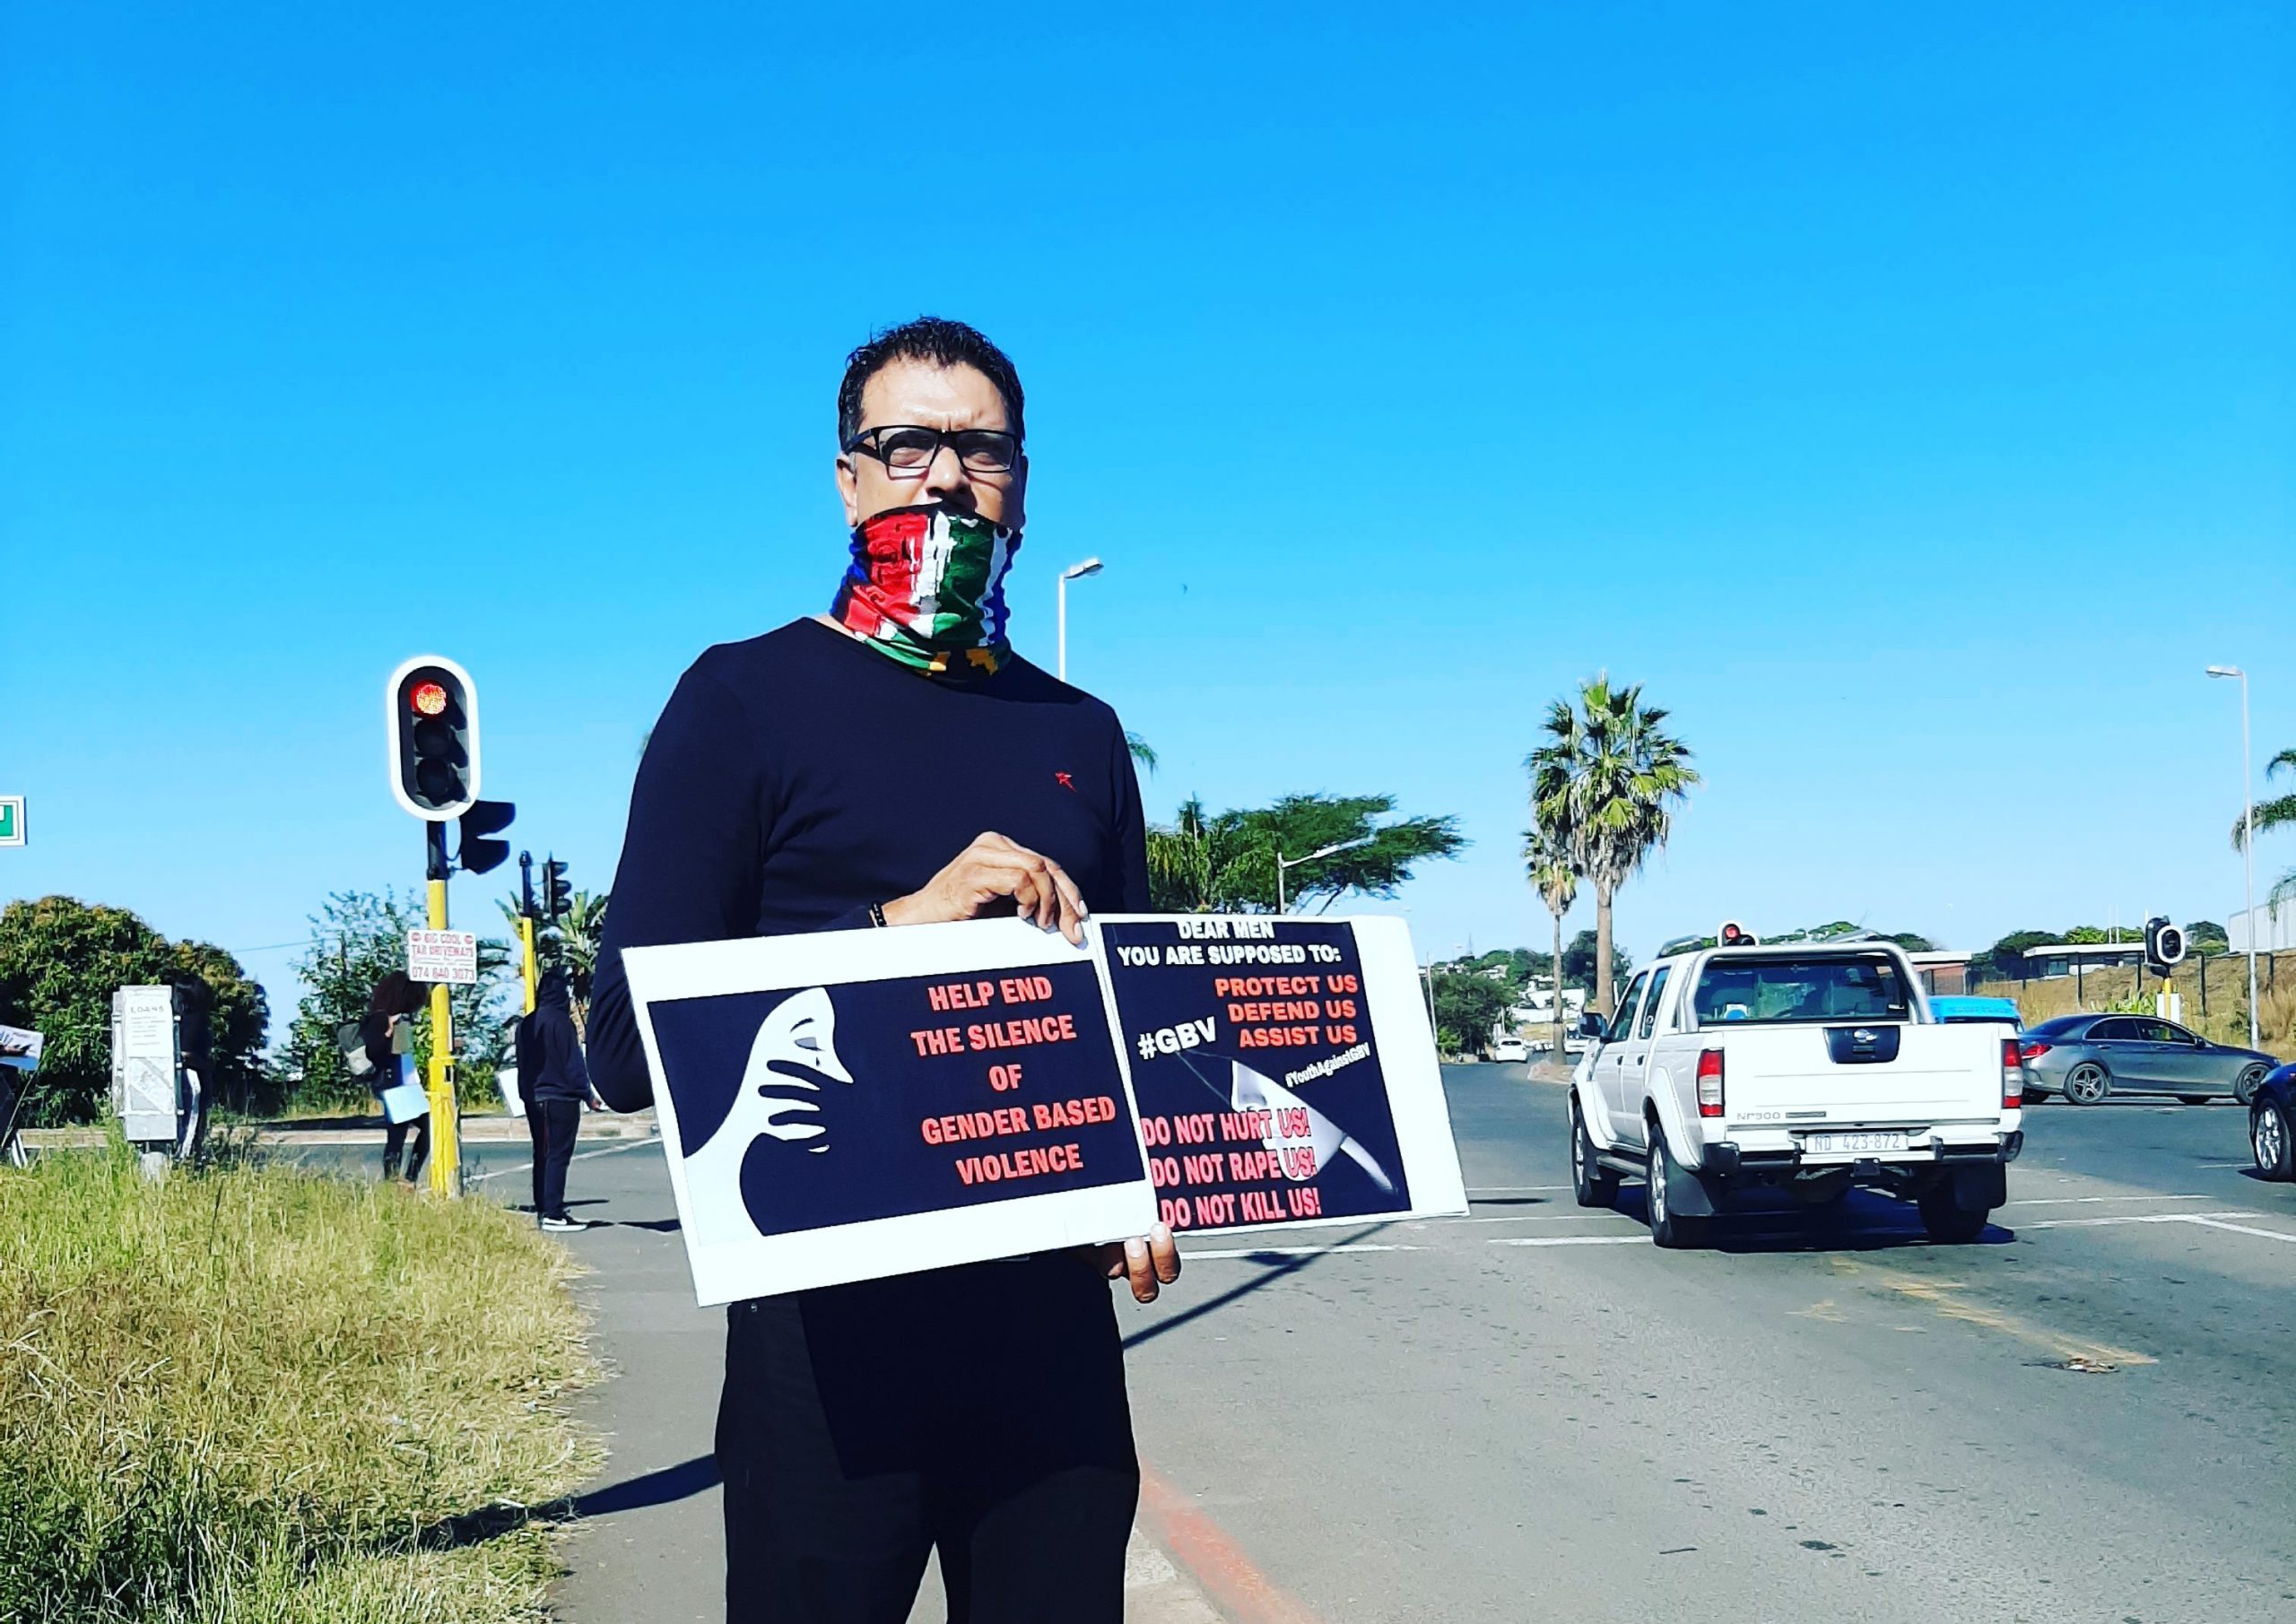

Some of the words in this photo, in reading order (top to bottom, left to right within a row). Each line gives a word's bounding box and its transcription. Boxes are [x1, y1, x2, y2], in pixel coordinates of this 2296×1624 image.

[1177, 921, 1229, 939] DEAR
[1232, 921, 1274, 939] MEN
[1117, 947, 1160, 967] YOU
[1165, 946, 1205, 965] ARE
[1208, 945, 1306, 965] SUPPOSED
[1309, 944, 1342, 963] TO:
[927, 978, 996, 1012] HELP
[999, 976, 1053, 1004] END
[1214, 976, 1320, 997] PROTECT
[1327, 975, 1359, 994] US
[1227, 1001, 1320, 1023] DEFEND
[1326, 1000, 1357, 1019] US
[910, 1027, 965, 1057] THE
[969, 1014, 1077, 1051] SILENCE
[1137, 1017, 1218, 1060] #GBV
[1239, 1025, 1320, 1048] ASSIST
[1326, 1025, 1358, 1044] US
[987, 1064, 1022, 1091] OF
[920, 1106, 1030, 1146] GENDER
[1034, 1095, 1117, 1132] BASED
[1141, 1116, 1171, 1147] DO
[1174, 1114, 1215, 1143] NOT
[1220, 1109, 1274, 1141] HURT
[1278, 1107, 1311, 1138] US!
[1815, 1134, 1831, 1151] ND
[1843, 1133, 1900, 1150] 423-872
[955, 1143, 1083, 1186] VIOLENCE
[1151, 1157, 1181, 1187] DO
[1184, 1154, 1225, 1185] NOT
[1229, 1150, 1283, 1182] RAPE
[1283, 1147, 1318, 1178] US!
[1159, 1198, 1192, 1228] DO
[1195, 1195, 1236, 1225] NOT
[1239, 1191, 1287, 1221] KILL
[1290, 1186, 1323, 1217] US!
